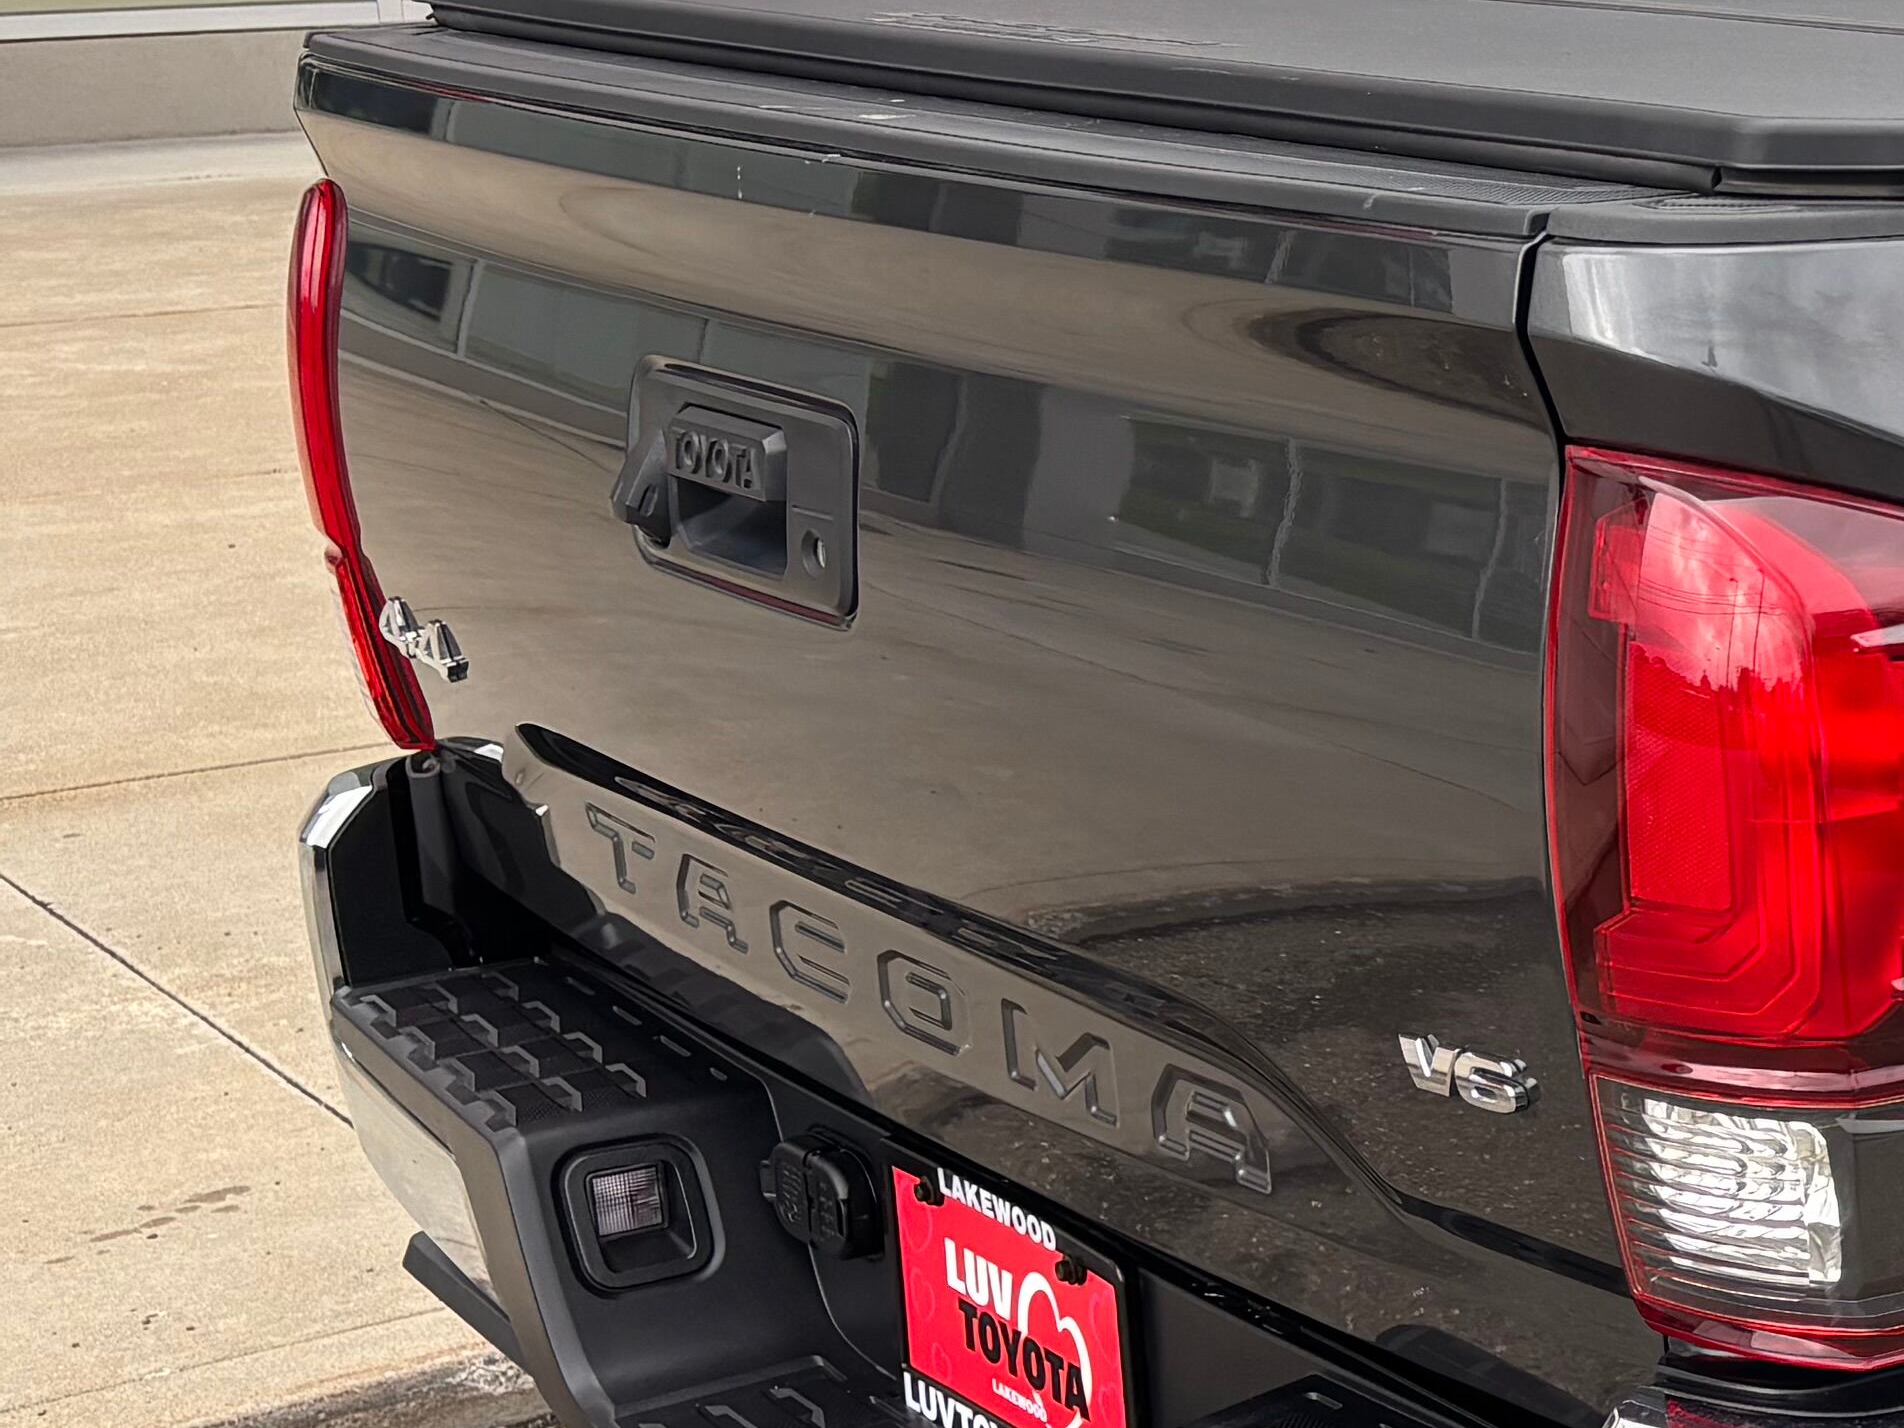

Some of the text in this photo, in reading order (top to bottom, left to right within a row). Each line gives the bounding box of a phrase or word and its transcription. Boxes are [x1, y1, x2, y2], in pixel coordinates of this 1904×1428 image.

[670, 423, 758, 492] TOYOTA
[585, 801, 1273, 1196] TACOMA
[1398, 1032, 1530, 1114] V6
[937, 1167, 1057, 1251] LAKEWOOD
[944, 1237, 1013, 1321] LUV
[958, 1297, 1092, 1423] TOYOTA
[992, 1378, 1048, 1423] LAKEWOOD
